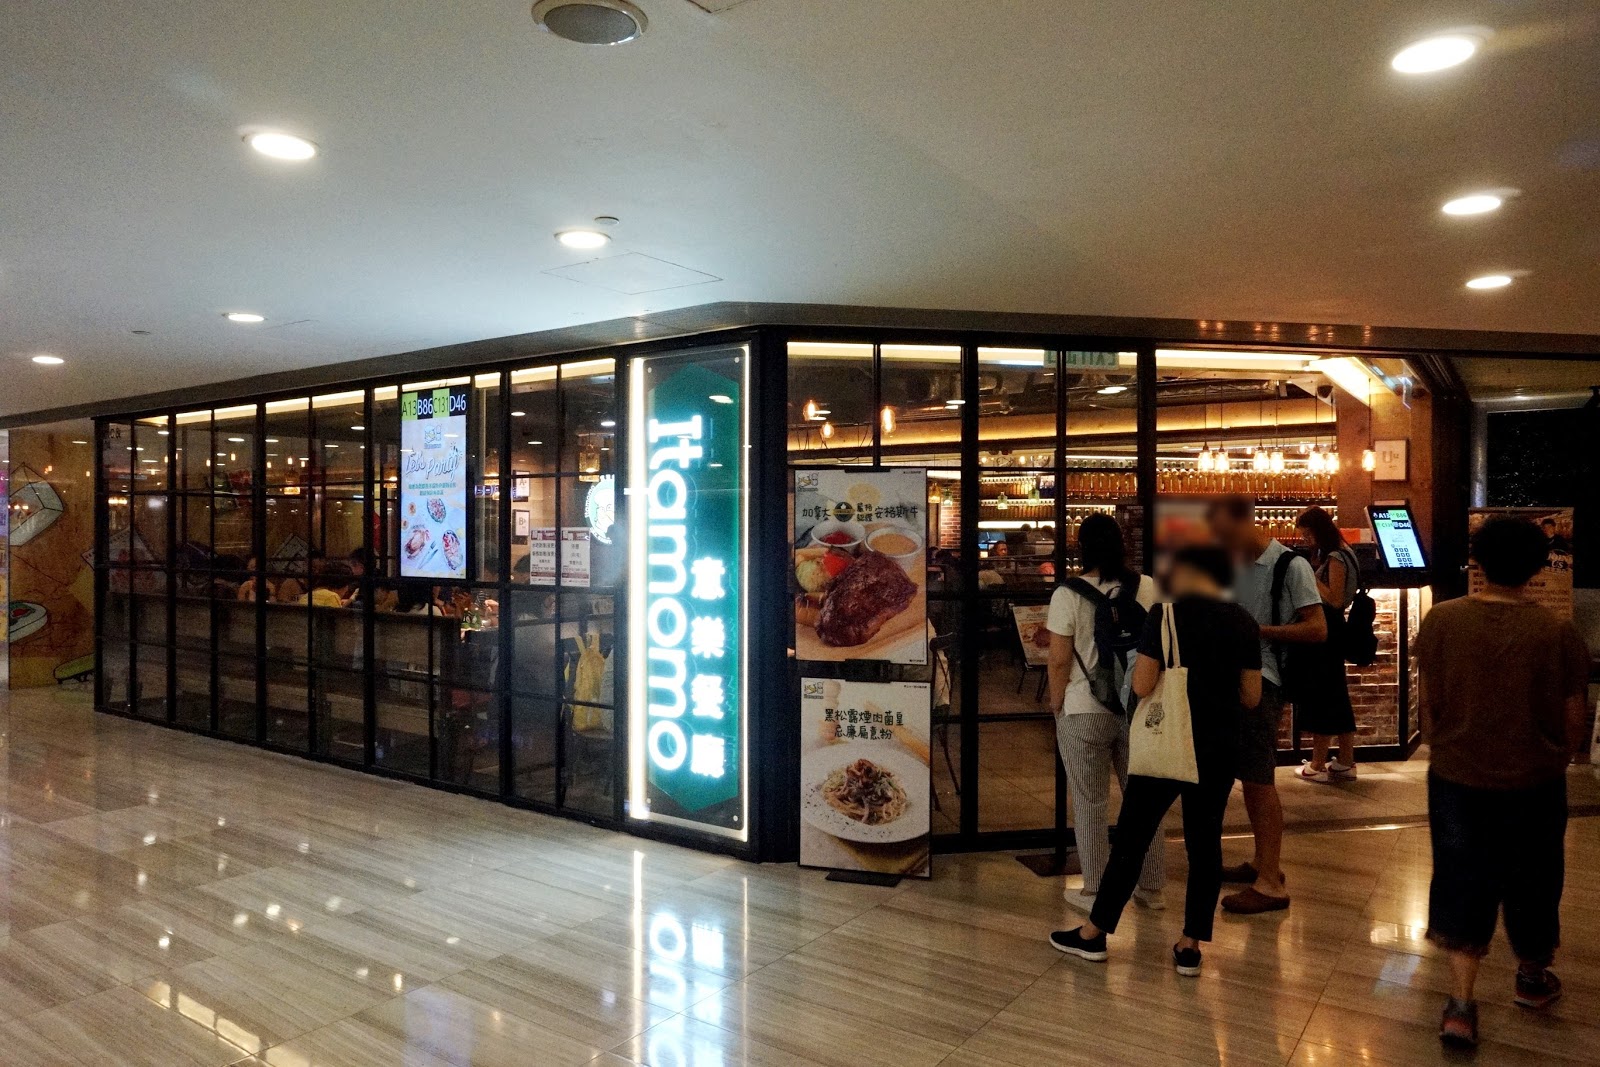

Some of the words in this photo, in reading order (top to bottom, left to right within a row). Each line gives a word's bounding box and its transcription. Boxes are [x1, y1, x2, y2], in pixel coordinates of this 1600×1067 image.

[402, 399, 417, 417] A13
[417, 397, 433, 416] B86
[449, 393, 467, 412] D46
[802, 505, 832, 521] 加拿大
[874, 504, 919, 519] 安格斯牛
[647, 414, 703, 771] Itamomo
[834, 724, 894, 740] 忌廉扁意粉
